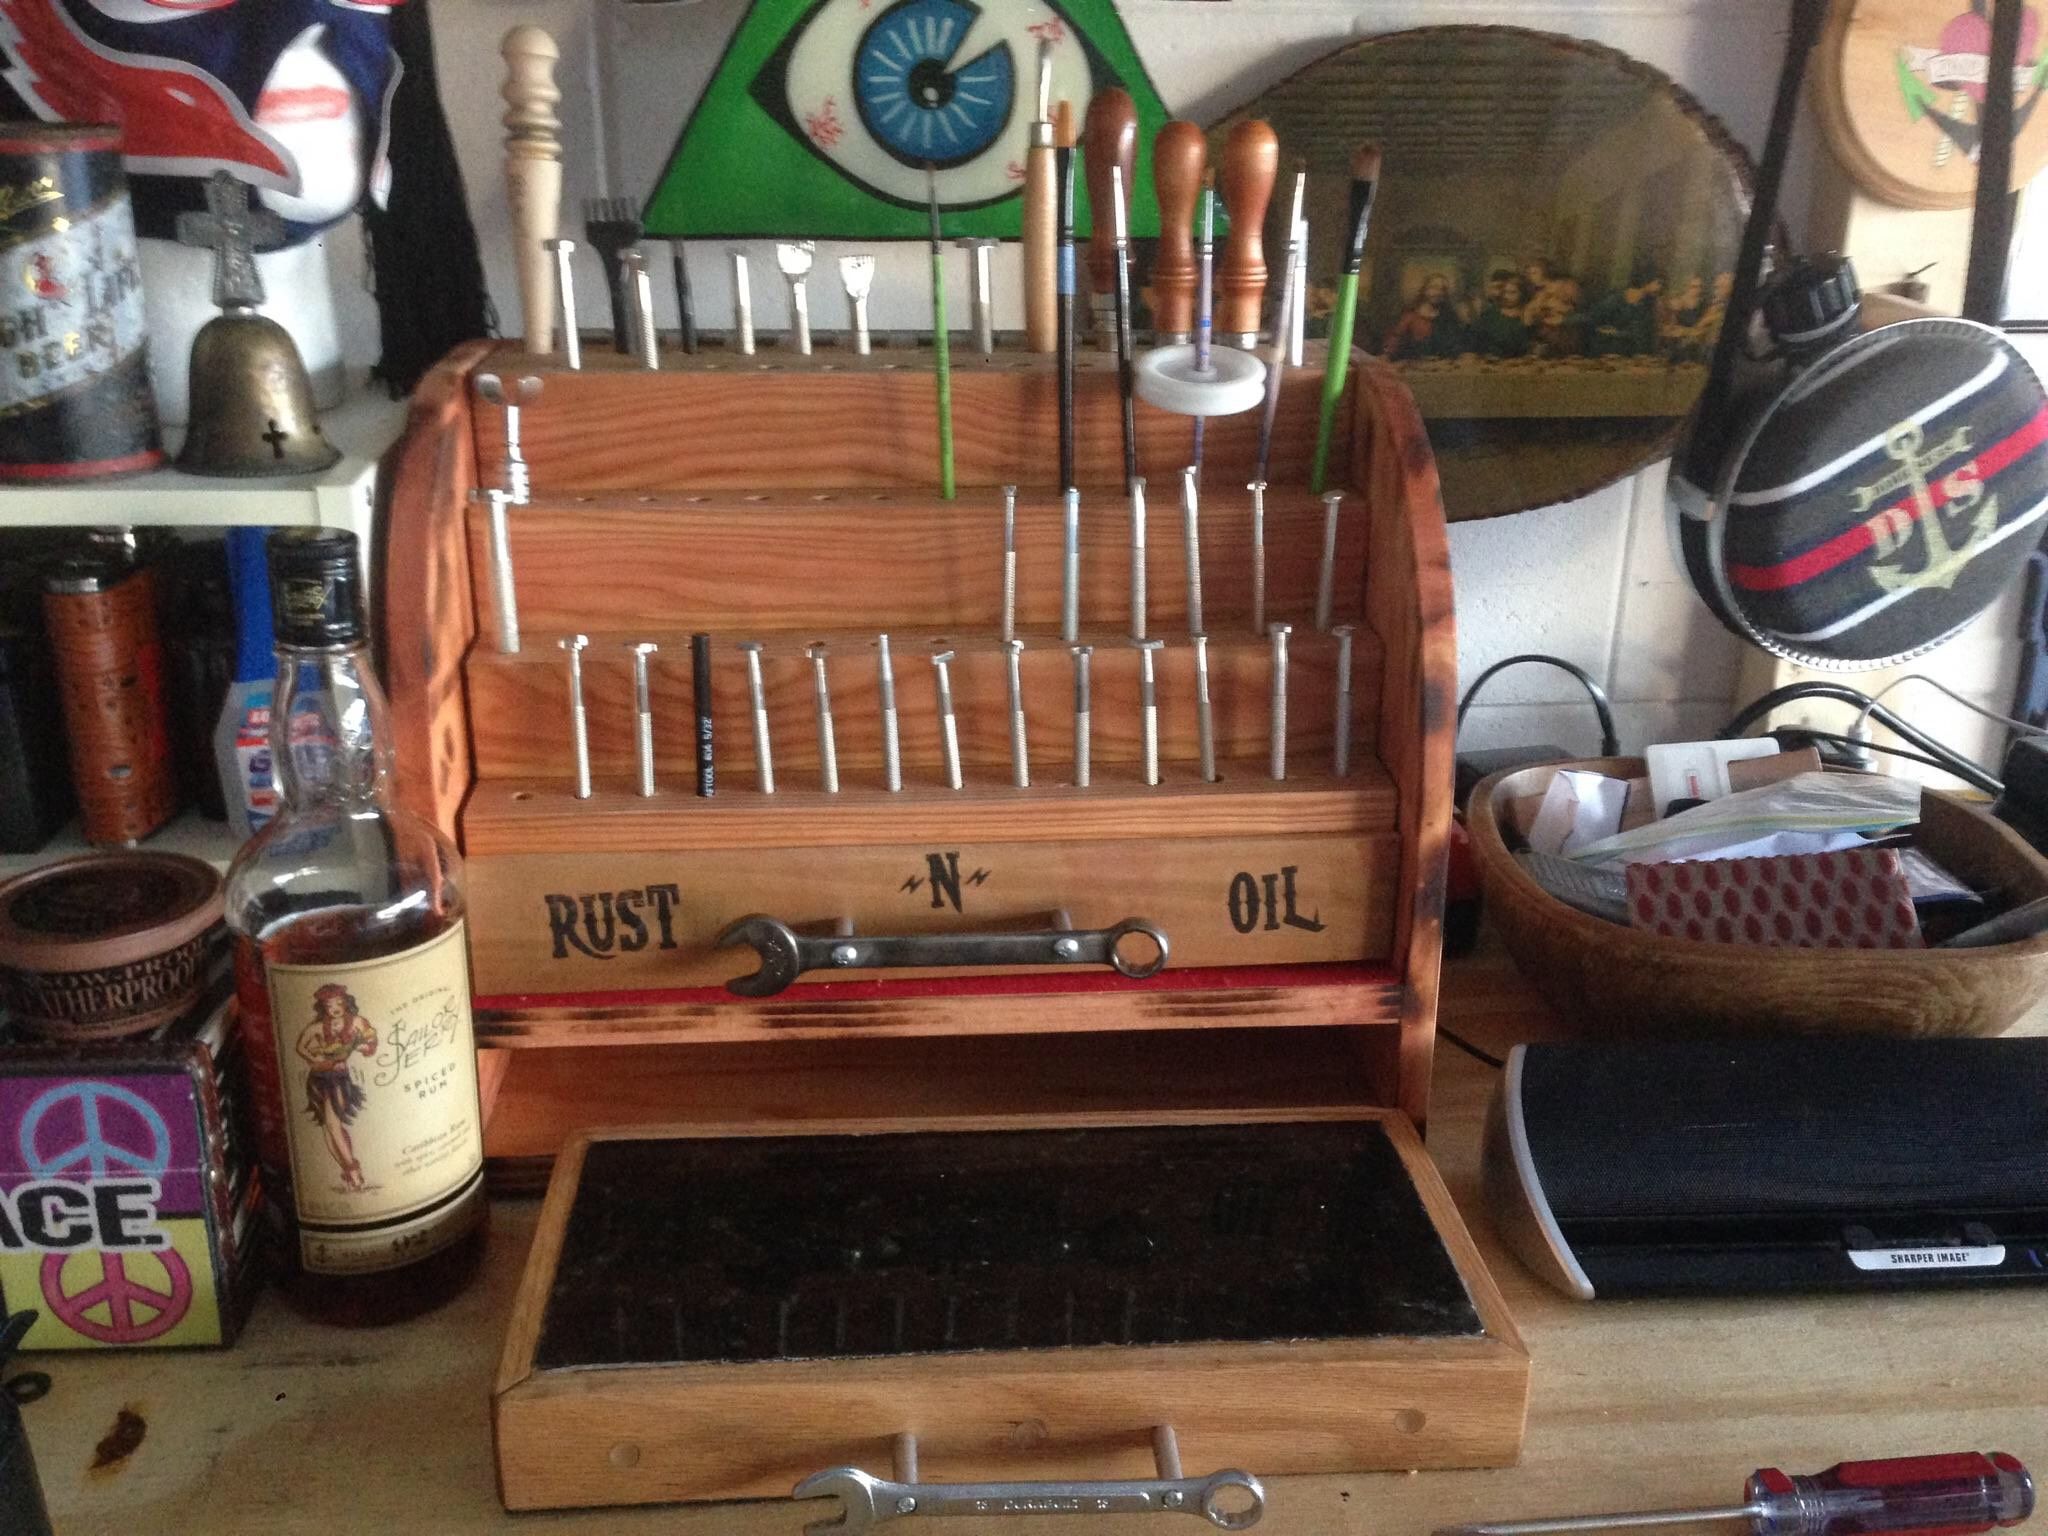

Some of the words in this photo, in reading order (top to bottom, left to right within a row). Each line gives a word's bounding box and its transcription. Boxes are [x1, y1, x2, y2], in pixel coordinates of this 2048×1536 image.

[544, 883, 681, 960] RUST
[1228, 865, 1328, 934] OIL
[403, 1062, 456, 1093] SPICED
[418, 1080, 447, 1099] RUM
[1891, 1253, 1935, 1264] SHARPER
[1937, 1252, 1968, 1263] IMAGE
